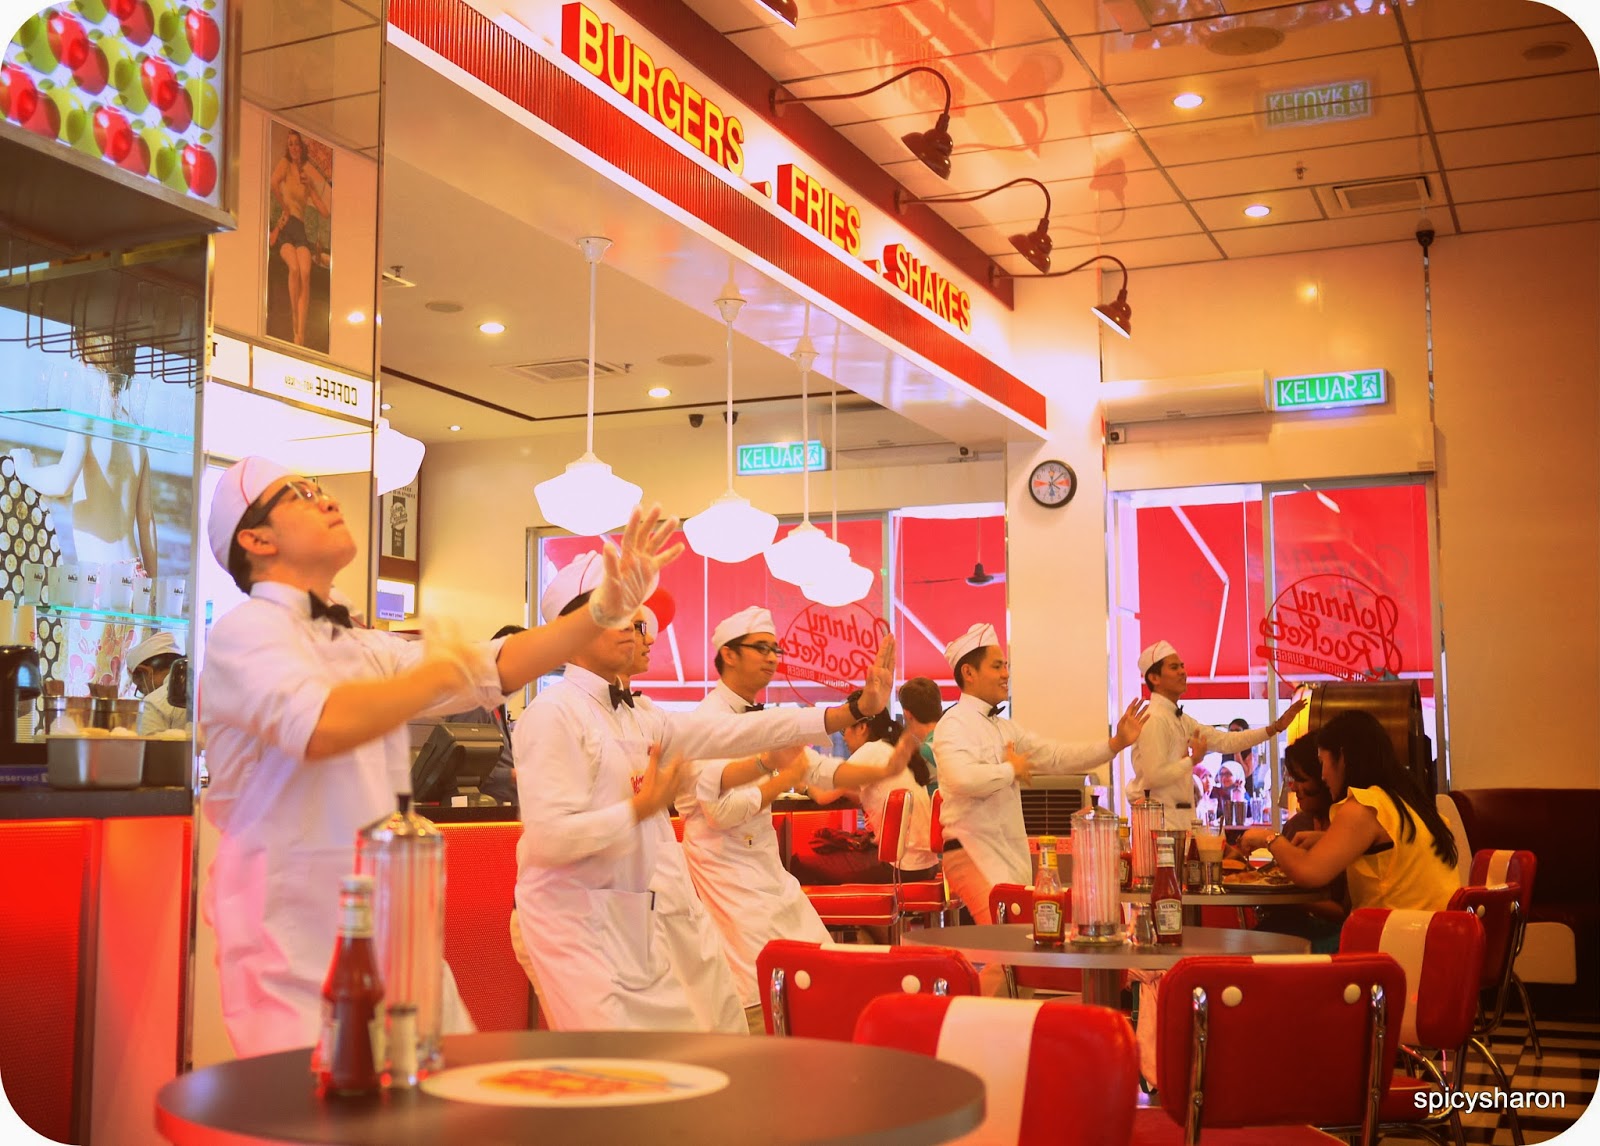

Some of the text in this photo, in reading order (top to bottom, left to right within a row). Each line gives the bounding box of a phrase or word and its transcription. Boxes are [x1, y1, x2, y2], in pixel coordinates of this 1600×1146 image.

[562, 2, 972, 336] BURGERS FRIES SHAKES
[1280, 377, 1358, 405] KELUAR
[742, 447, 803, 470] KELUAR
